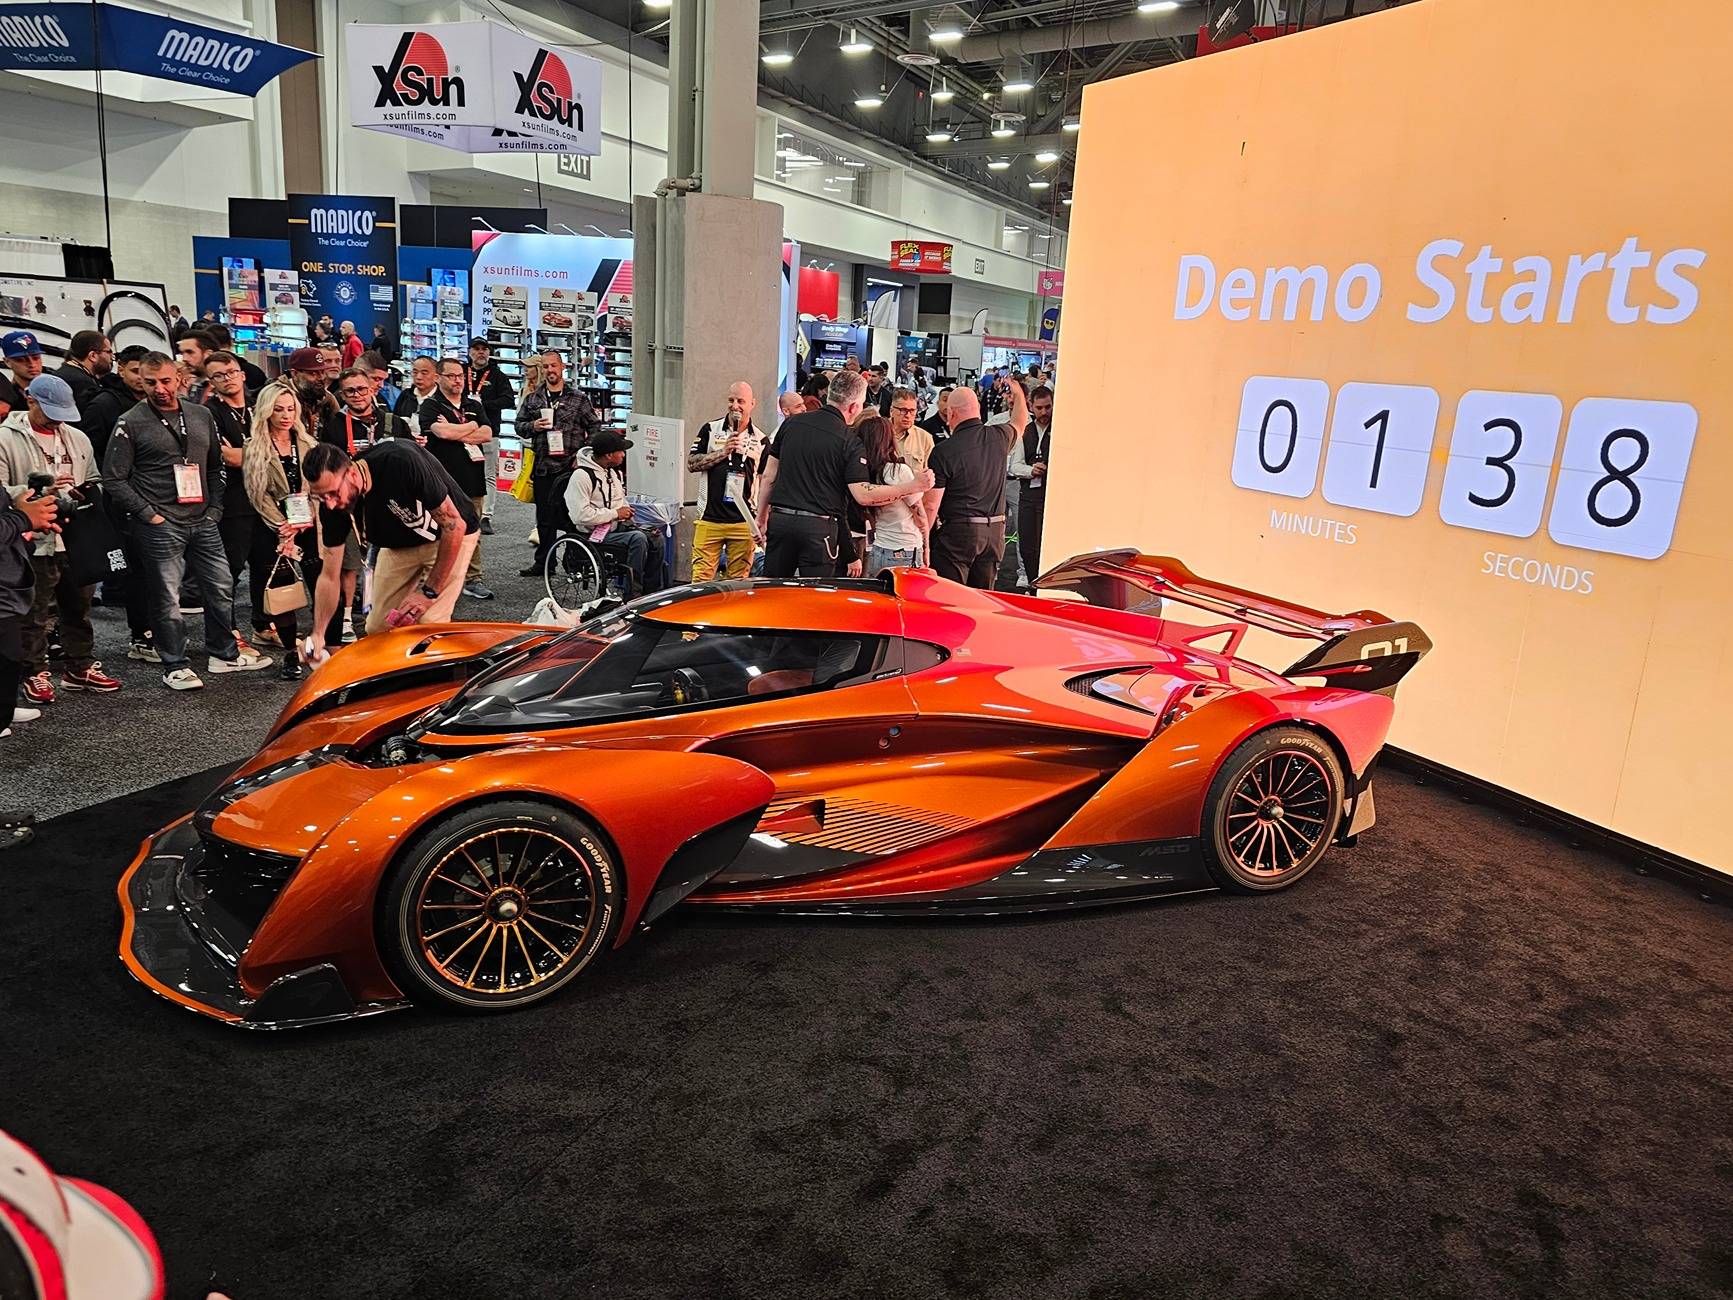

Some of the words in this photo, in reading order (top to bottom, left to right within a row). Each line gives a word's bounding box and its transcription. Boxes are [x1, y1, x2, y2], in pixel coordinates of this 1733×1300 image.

[157, 29, 254, 73] MADICO
[160, 62, 177, 73] The
[178, 67, 201, 78] Clear
[202, 72, 230, 84] Choice
[371, 31, 466, 108] XSun
[512, 48, 584, 132] XSun
[383, 110, 457, 121] xsunfilms.com
[521, 120, 578, 142] xsunfilms.com
[498, 141, 567, 151] xsunfilms.com
[560, 155, 590, 175] EXIT
[310, 208, 374, 235] MADICO
[317, 237, 329, 246] The
[330, 238, 345, 246] Clear
[346, 238, 368, 247] Choice
[301, 261, 326, 273] ONE.
[328, 263, 355, 275] STOP.
[357, 264, 387, 276] SHOP.
[483, 265, 569, 280] xsunfilms.com
[1173, 253, 1383, 322] Demo
[1405, 236, 1708, 326] Starts
[1269, 509, 1359, 546] MINUTES
[1481, 551, 1596, 596] SECONDS
[1280, 737, 1323, 754] GOODYEAR
[581, 837, 613, 894] GOODYEAR
